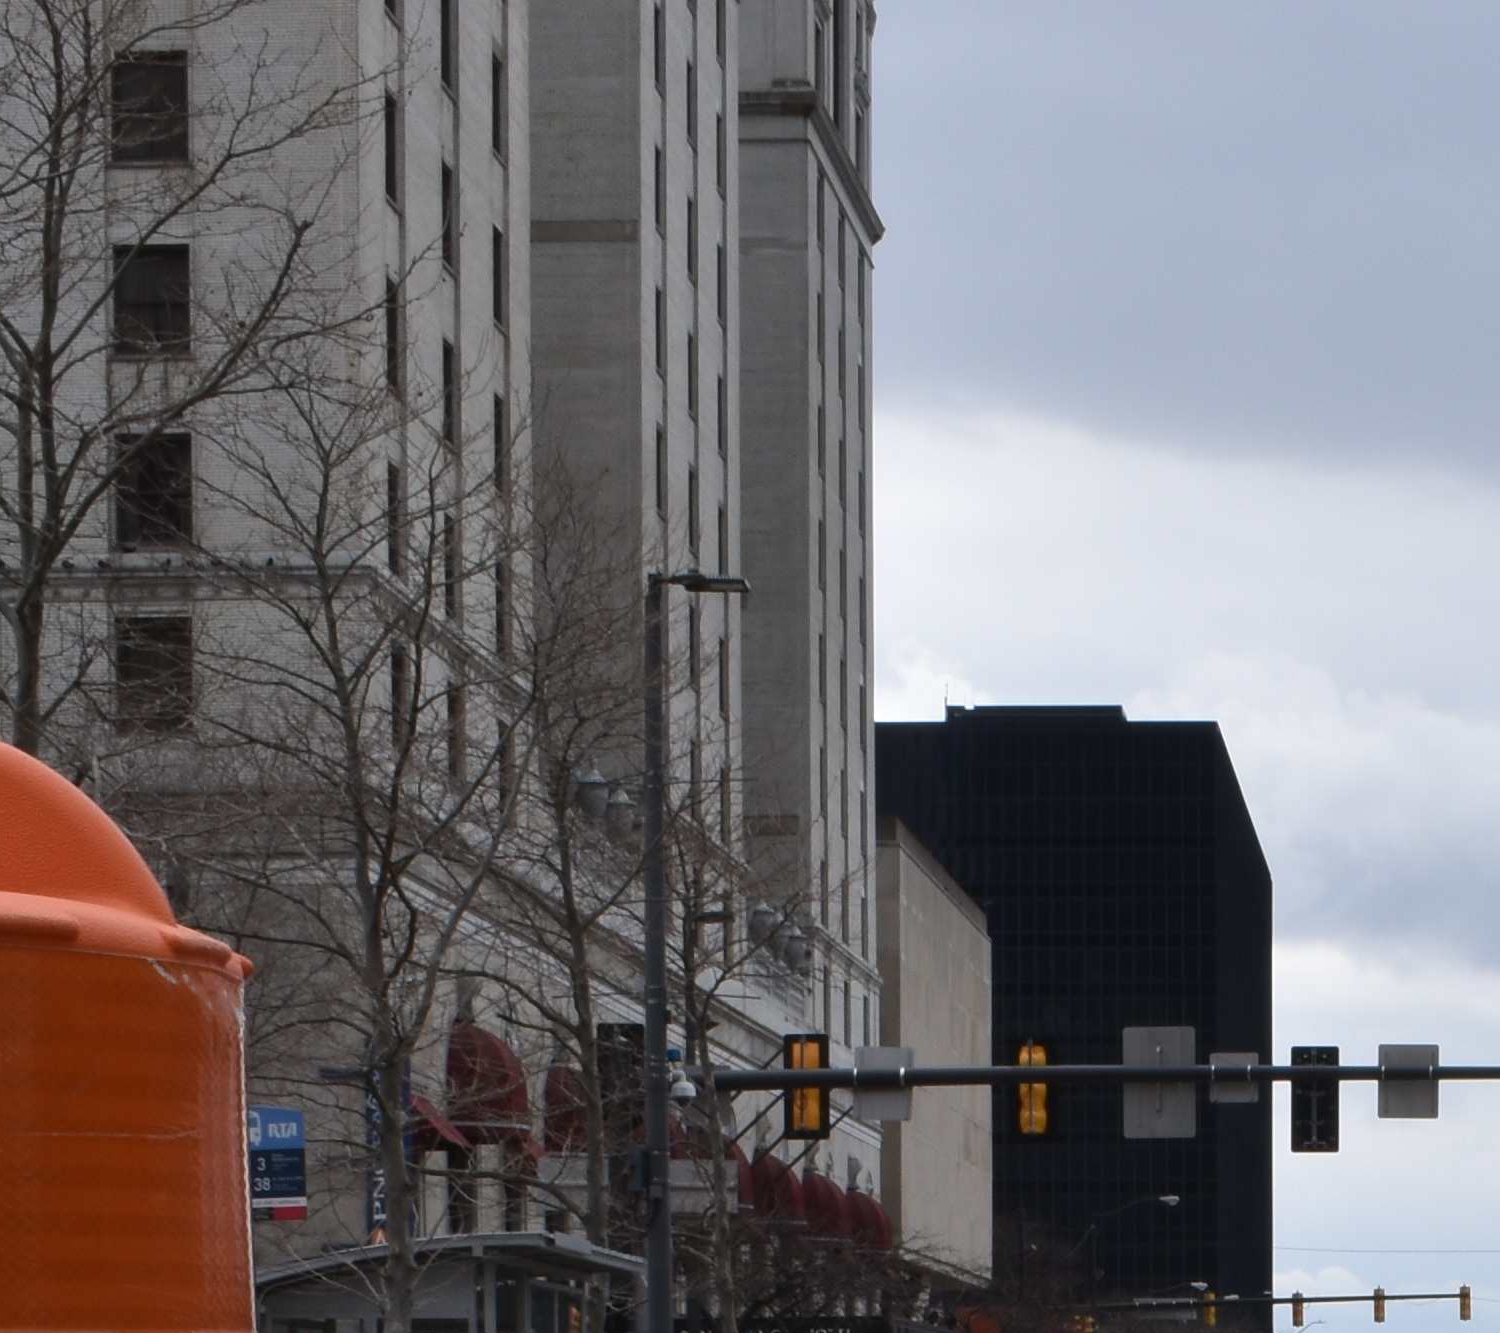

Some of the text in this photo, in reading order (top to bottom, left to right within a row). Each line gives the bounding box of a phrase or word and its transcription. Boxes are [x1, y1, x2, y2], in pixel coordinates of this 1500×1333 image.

[267, 1122, 297, 1138] RTA
[257, 1157, 266, 1171] 3
[254, 1177, 271, 1192] 38
